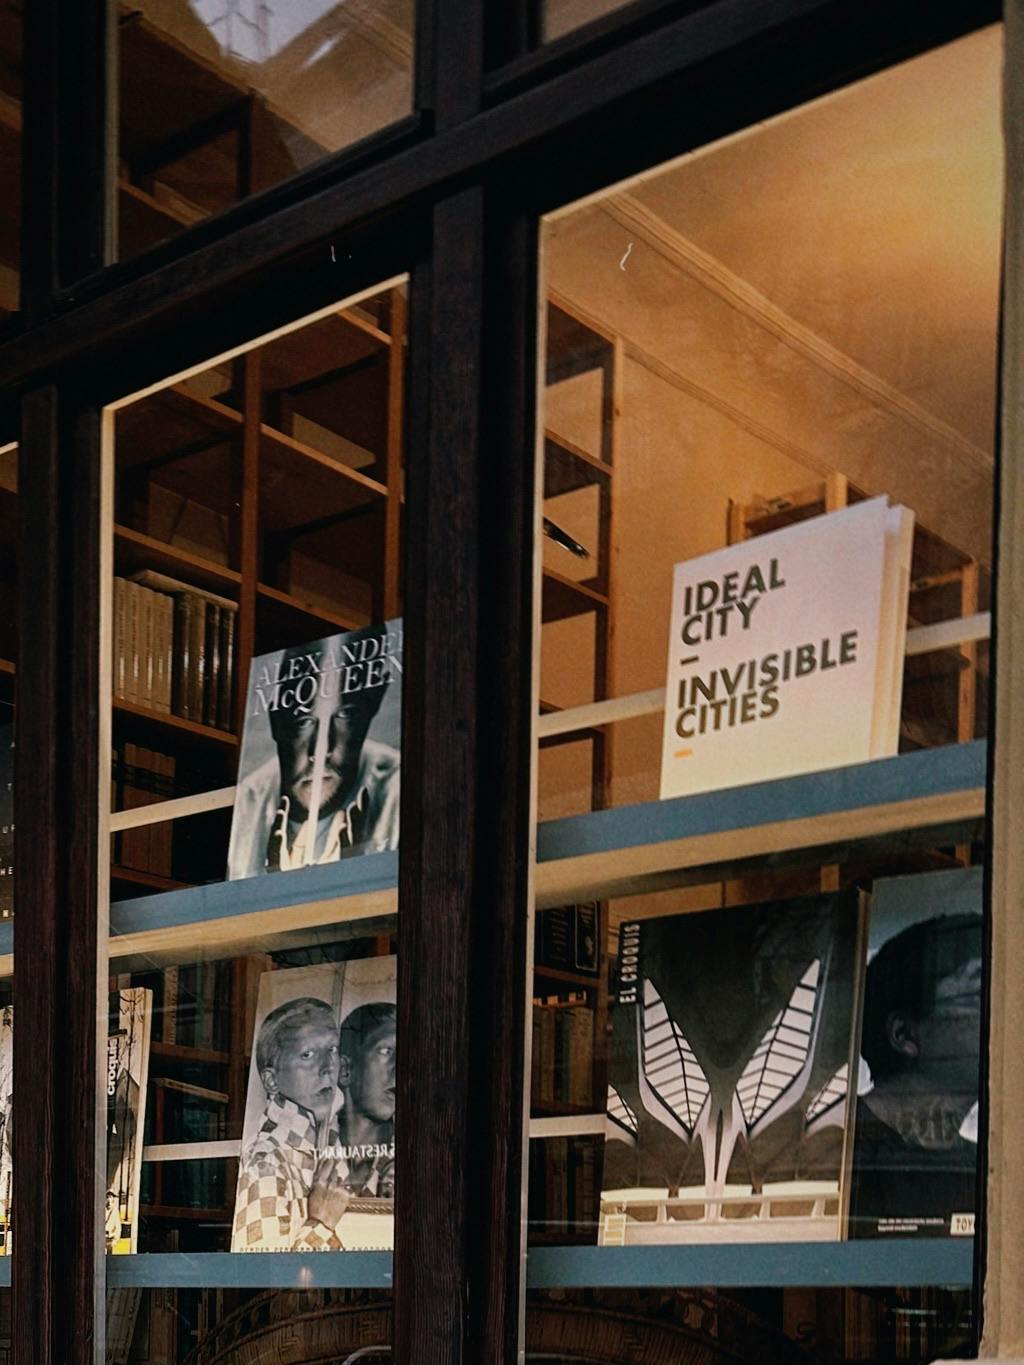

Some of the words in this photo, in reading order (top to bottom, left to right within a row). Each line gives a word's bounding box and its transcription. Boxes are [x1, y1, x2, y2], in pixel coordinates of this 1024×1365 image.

[683, 558, 786, 616] IDEAL
[681, 597, 759, 647] CITY
[678, 630, 859, 709] INVISIBLE
[676, 685, 781, 739] CITIES
[621, 923, 640, 981] CROQUIS
[619, 981, 637, 1003] EL
[107, 1037, 119, 1096] croquis
